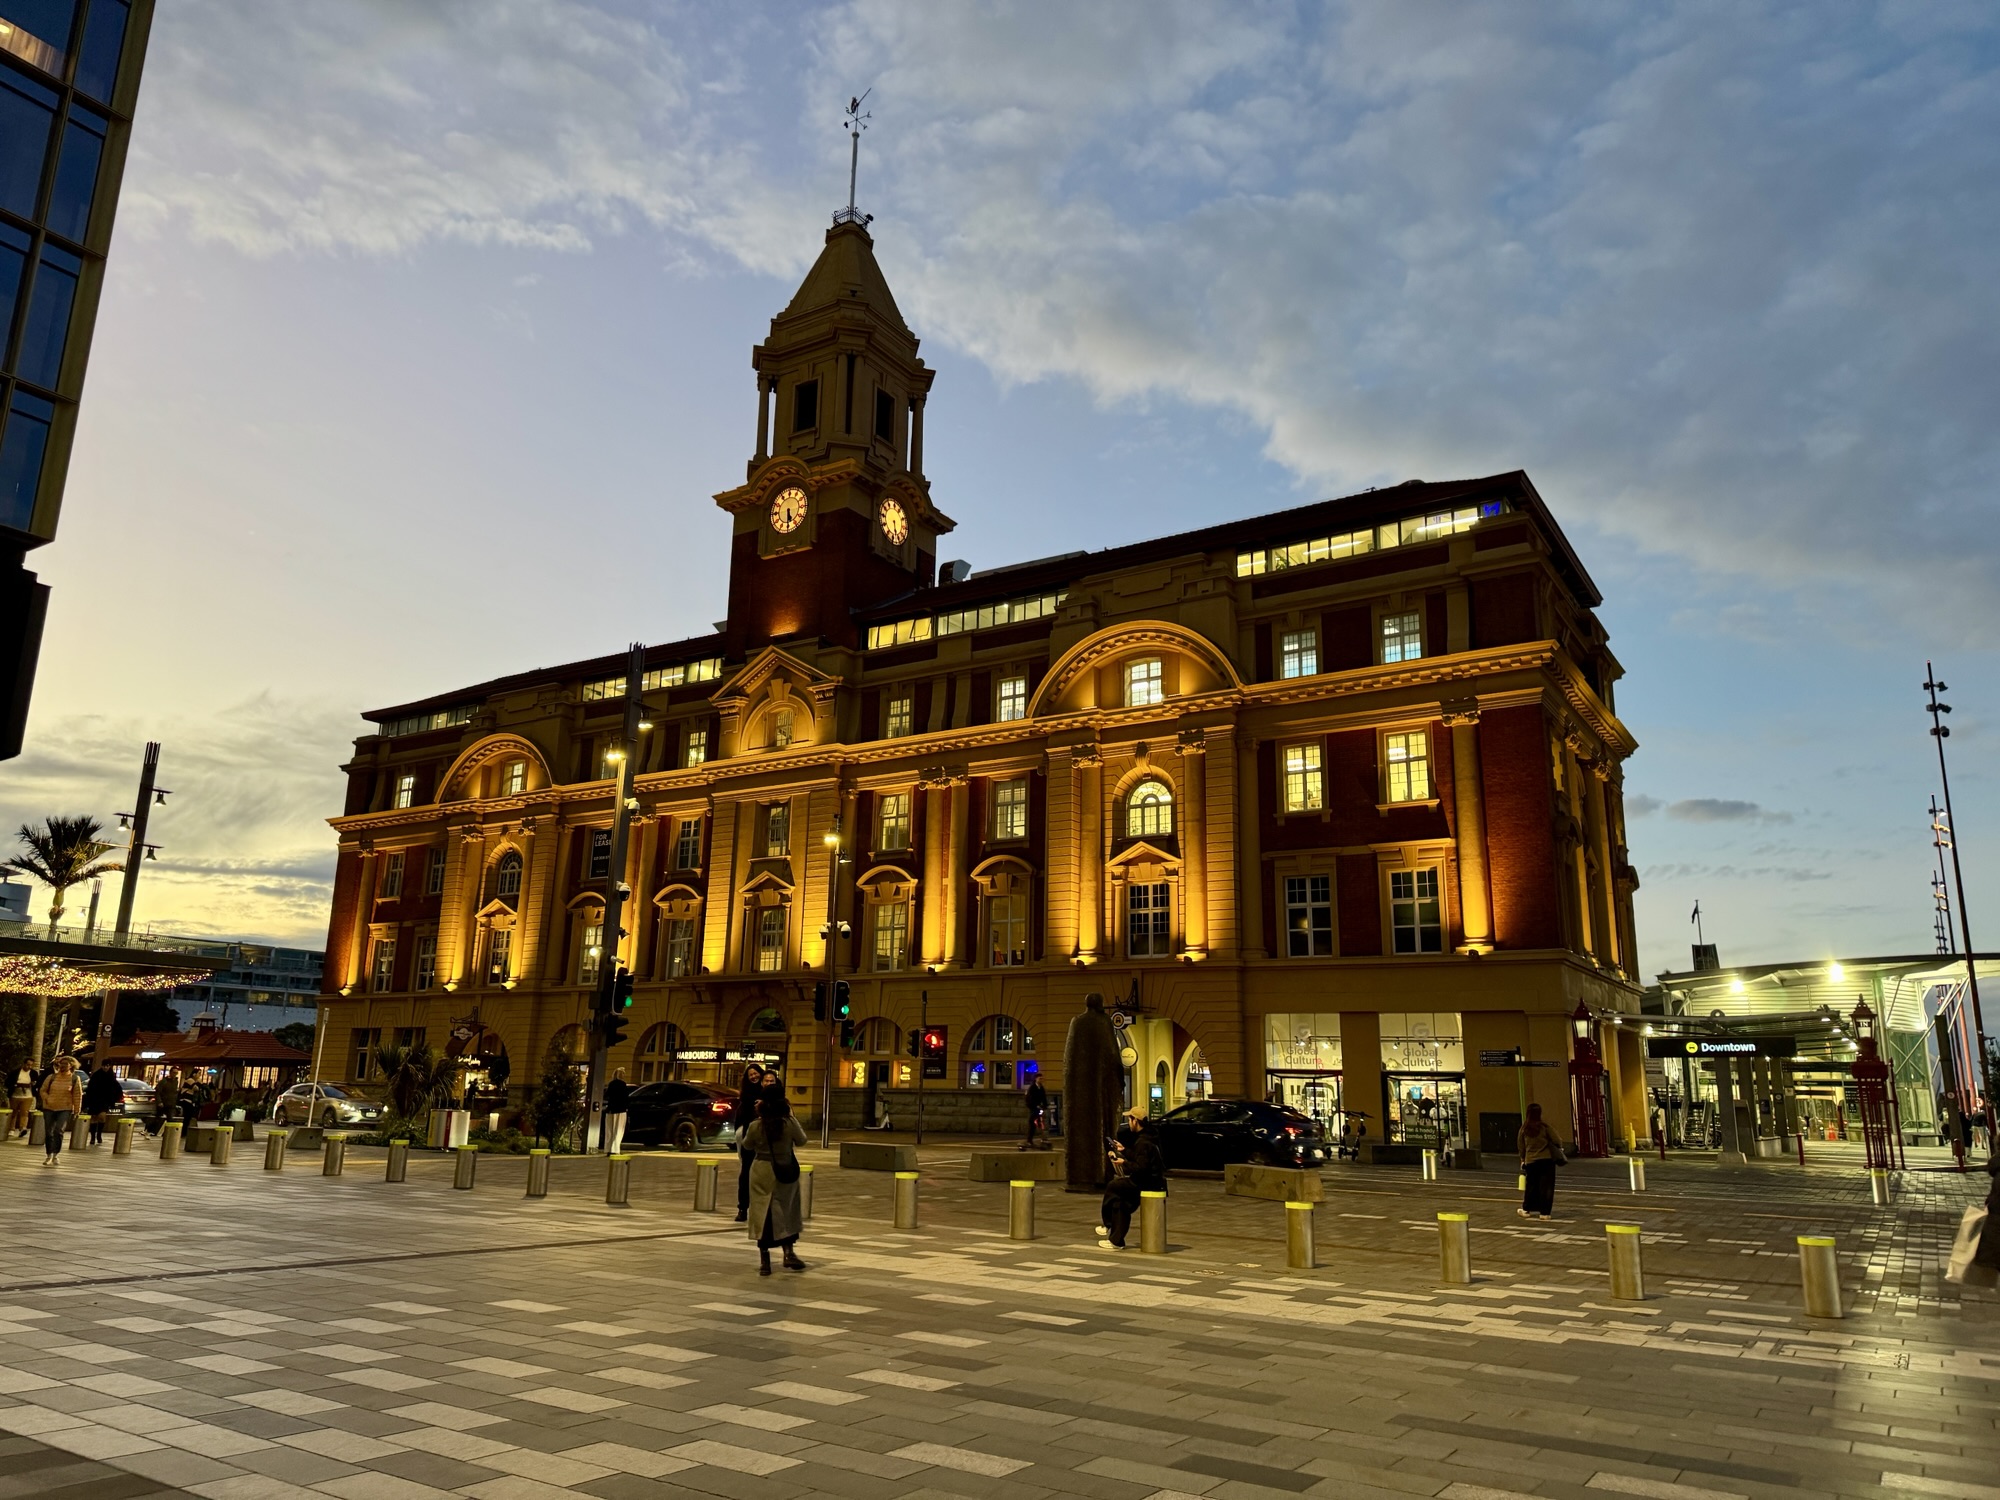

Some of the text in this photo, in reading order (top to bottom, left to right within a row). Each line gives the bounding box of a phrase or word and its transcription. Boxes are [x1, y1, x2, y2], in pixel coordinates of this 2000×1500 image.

[1402, 1047, 1438, 1057] Global
[1701, 1042, 1756, 1052] Downtown
[676, 1051, 718, 1060] HARBOURSIDE
[1285, 1056, 1322, 1065] Culture
[1401, 1057, 1443, 1067] Culture
